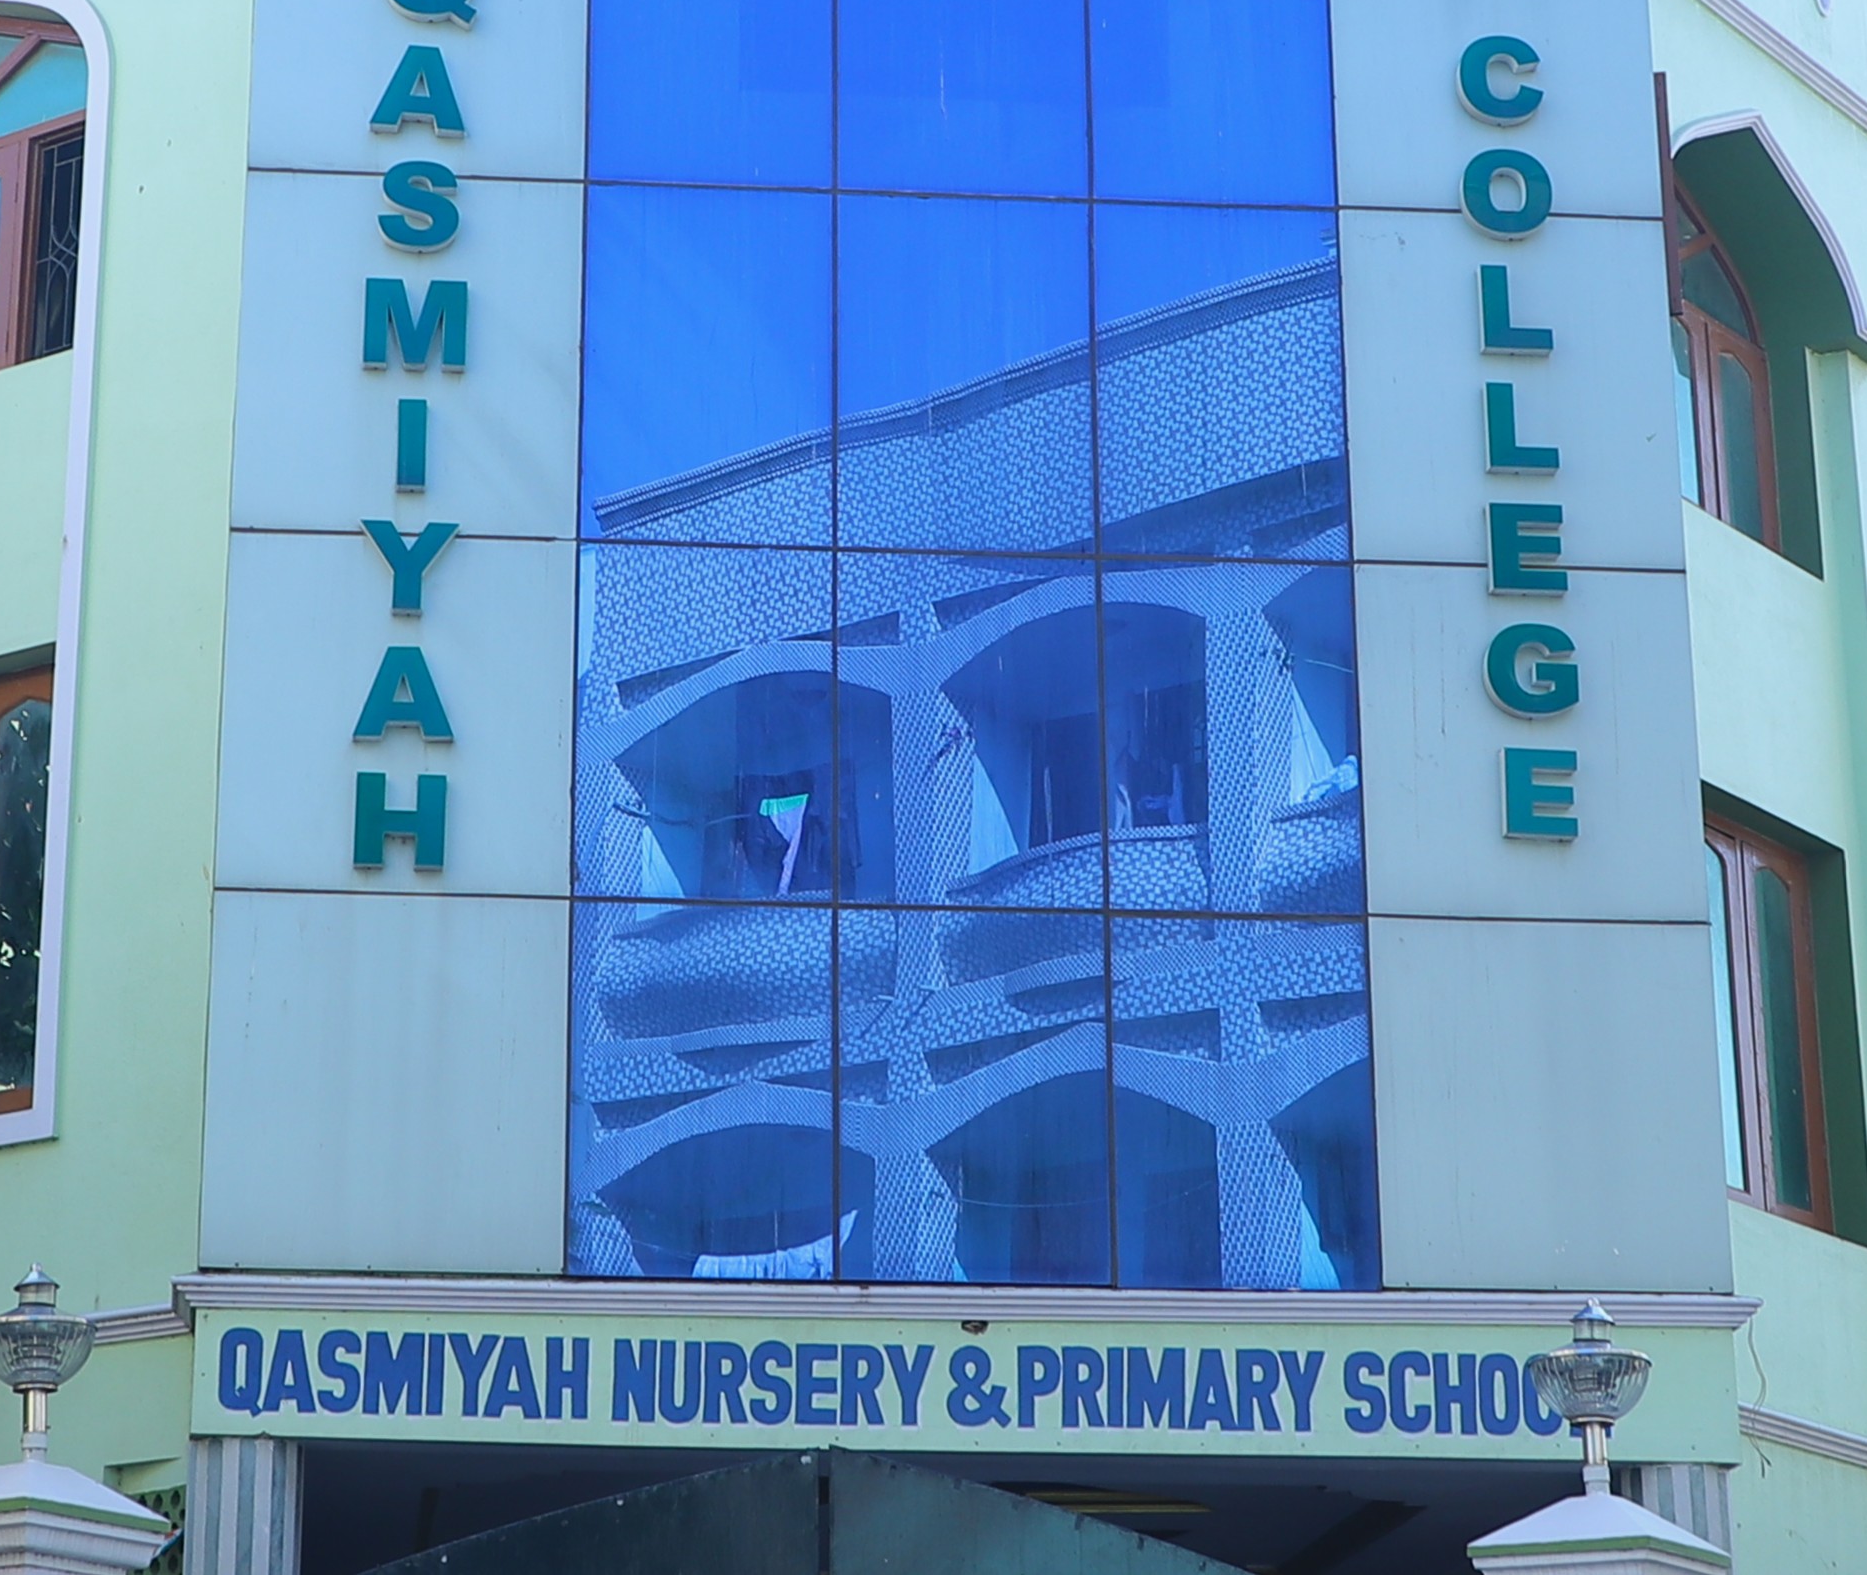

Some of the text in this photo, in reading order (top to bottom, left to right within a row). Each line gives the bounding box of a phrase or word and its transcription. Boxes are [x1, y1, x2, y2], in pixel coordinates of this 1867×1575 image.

[1455, 33, 1581, 844] COLLEGE
[218, 1327, 1611, 1438] QASMIYAH NURSERY & PRIMARY SCHOO
